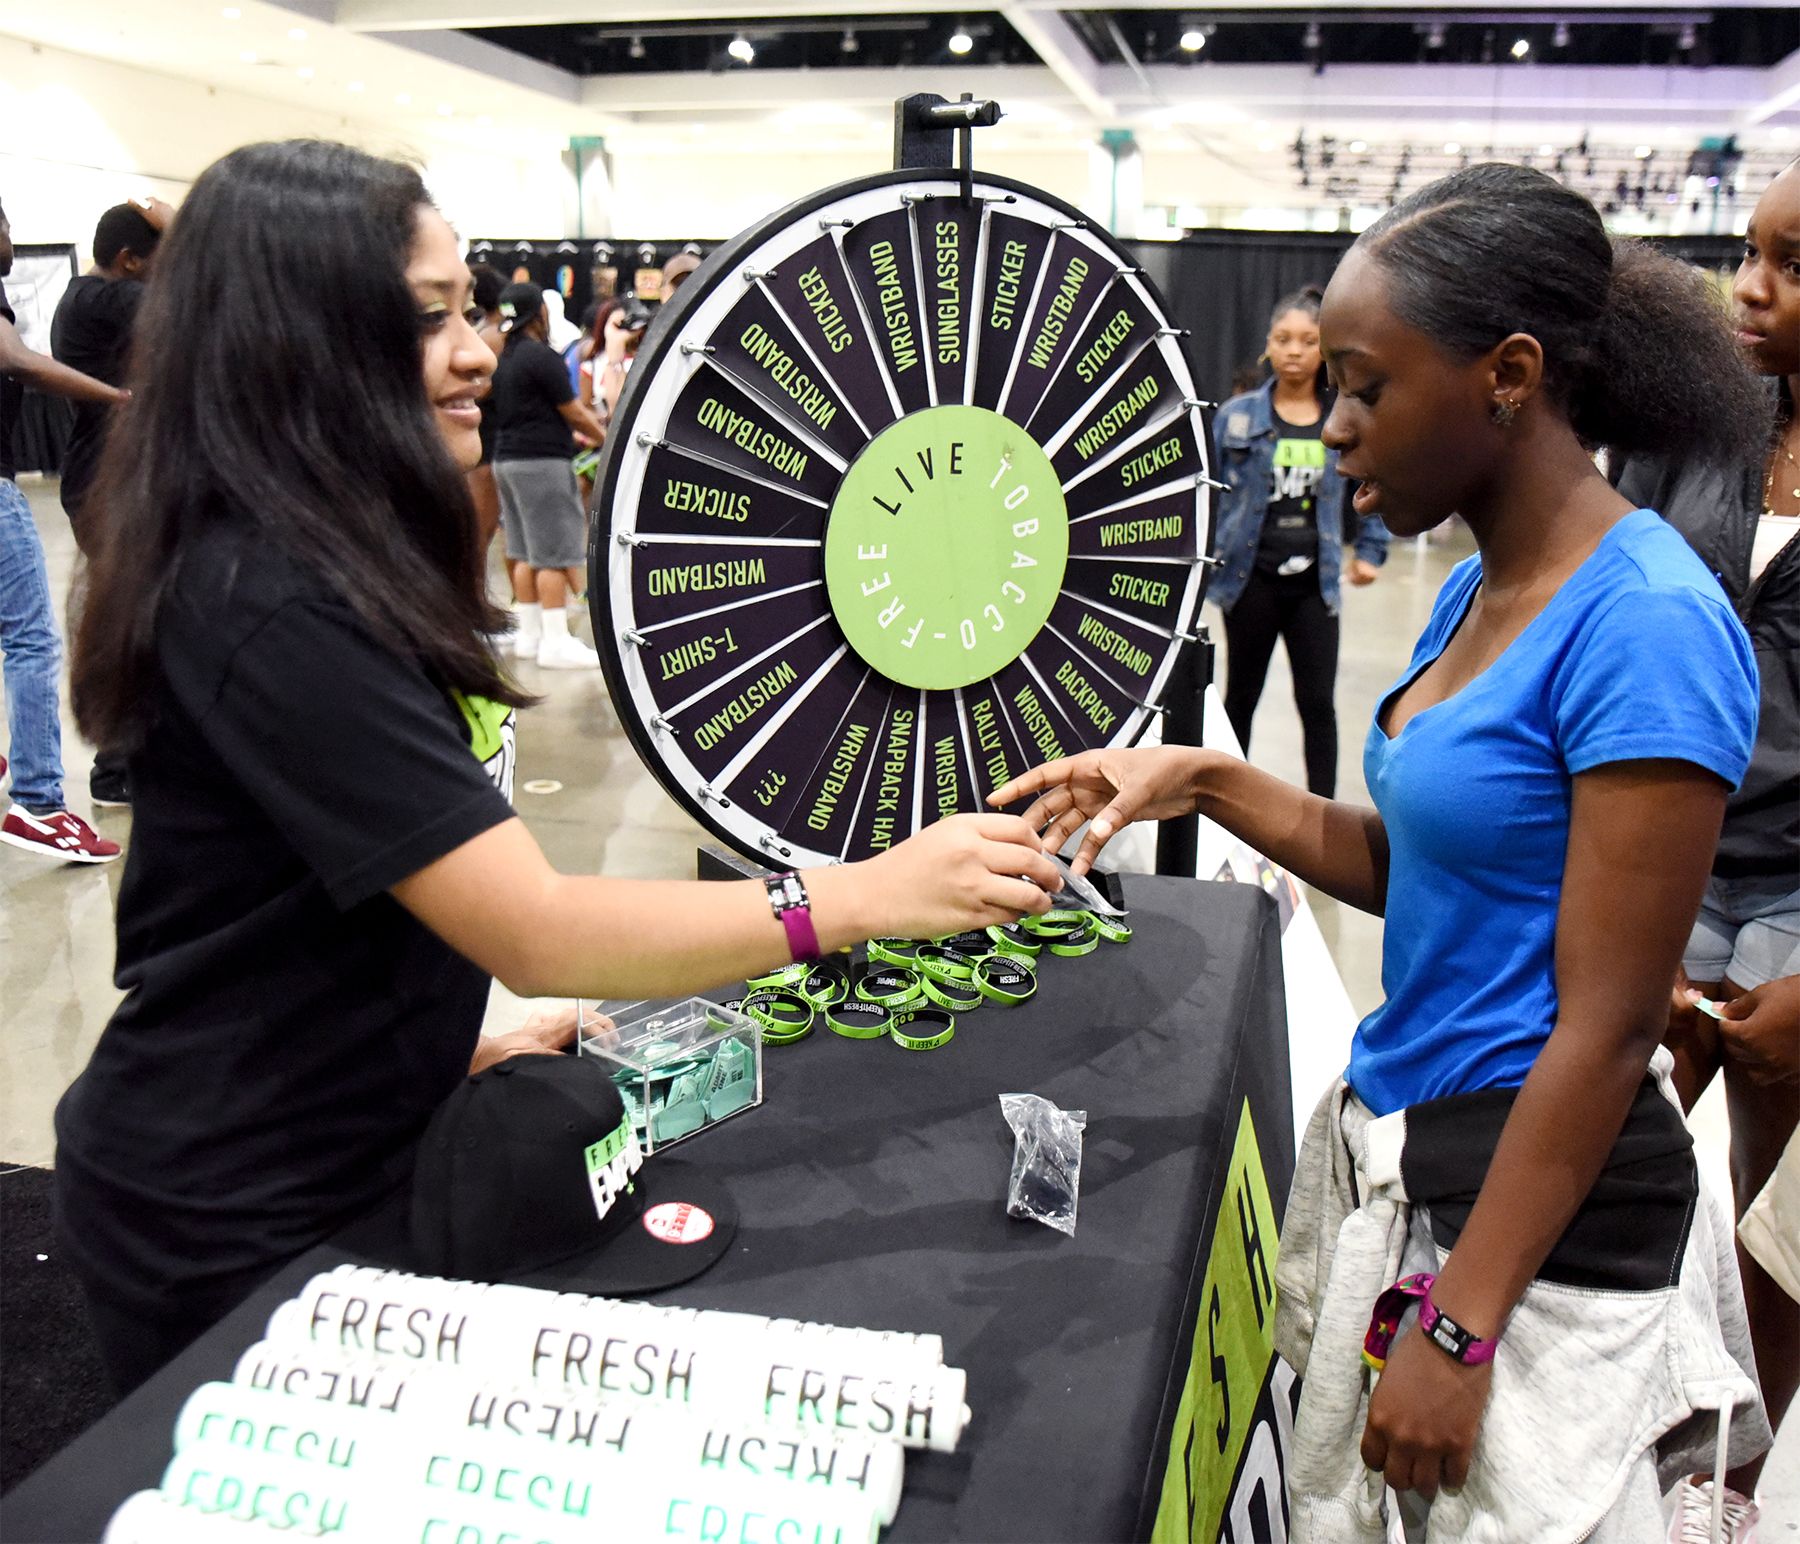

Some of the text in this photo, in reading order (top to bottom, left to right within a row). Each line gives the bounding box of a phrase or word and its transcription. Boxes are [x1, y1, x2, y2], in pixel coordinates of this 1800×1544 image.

[798, 265, 853, 353] STICKER
[869, 240, 918, 372] WRISTBAND
[936, 221, 960, 364] SUNGLASSES
[991, 240, 1028, 330] STICKER
[1027, 257, 1089, 370] WRISTBAND
[740, 323, 838, 431] WRISTBAND
[1075, 309, 1135, 384] STICKER
[697, 398, 808, 481] WRISTBAND
[1073, 375, 1159, 461] WRISTBAND
[872, 443, 963, 516] LIVE
[1120, 437, 1184, 487] STICKER
[664, 479, 751, 522] STICKER
[1100, 515, 1183, 548] WRISTBAND
[648, 558, 766, 597] WRISTBAND
[1108, 573, 1170, 607] STICKER
[659, 627, 739, 681] T-SHIRT
[1077, 613, 1152, 677] WRISTBAND
[693, 660, 798, 752] WRISTBAND
[1014, 684, 1066, 762] WRISTBAN
[1055, 660, 1117, 735] BACKPACK
[808, 723, 870, 831] WRISTBAND
[870, 709, 914, 851] SNAPBACK HAT
[935, 735, 959, 820] WRISTBA
[972, 699, 1011, 791] RALLY TOW
[757, 769, 787, 807] ???
[999, 974, 1020, 984] FRESH
[917, 1039, 933, 1049] KEEP
[309, 1291, 468, 1365] FRESH
[532, 1327, 696, 1402] FRESH
[764, 1363, 935, 1441] FRESH
